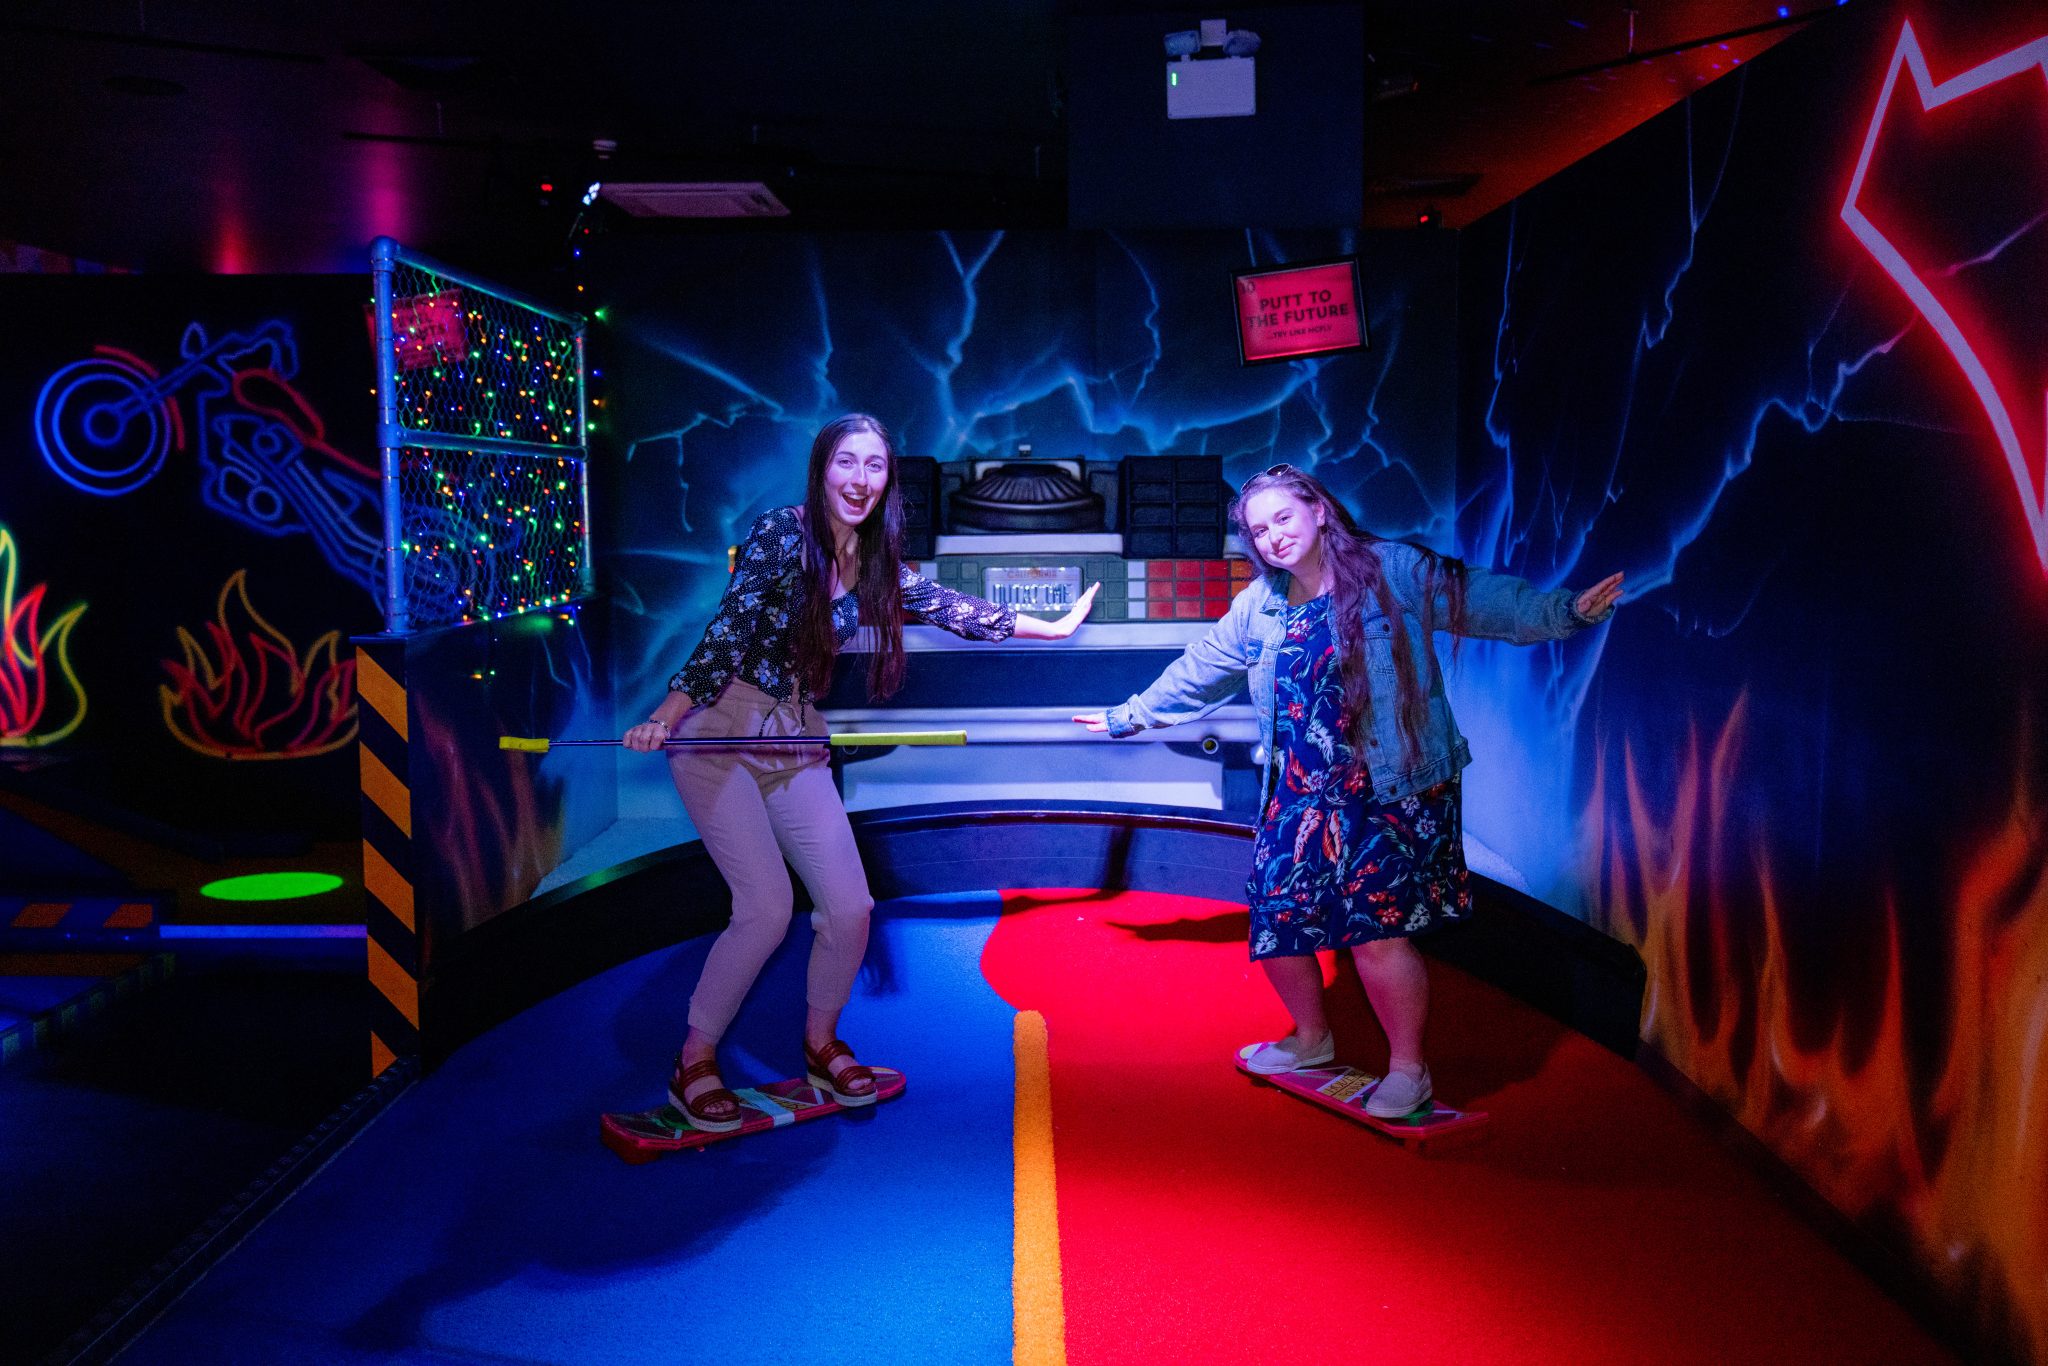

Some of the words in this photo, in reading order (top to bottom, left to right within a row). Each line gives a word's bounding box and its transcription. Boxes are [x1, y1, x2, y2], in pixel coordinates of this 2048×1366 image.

[1260, 294, 1302, 311] PUTT
[1309, 290, 1332, 304] TO
[1246, 312, 1279, 328] THE
[1284, 303, 1349, 324] FUTURE
